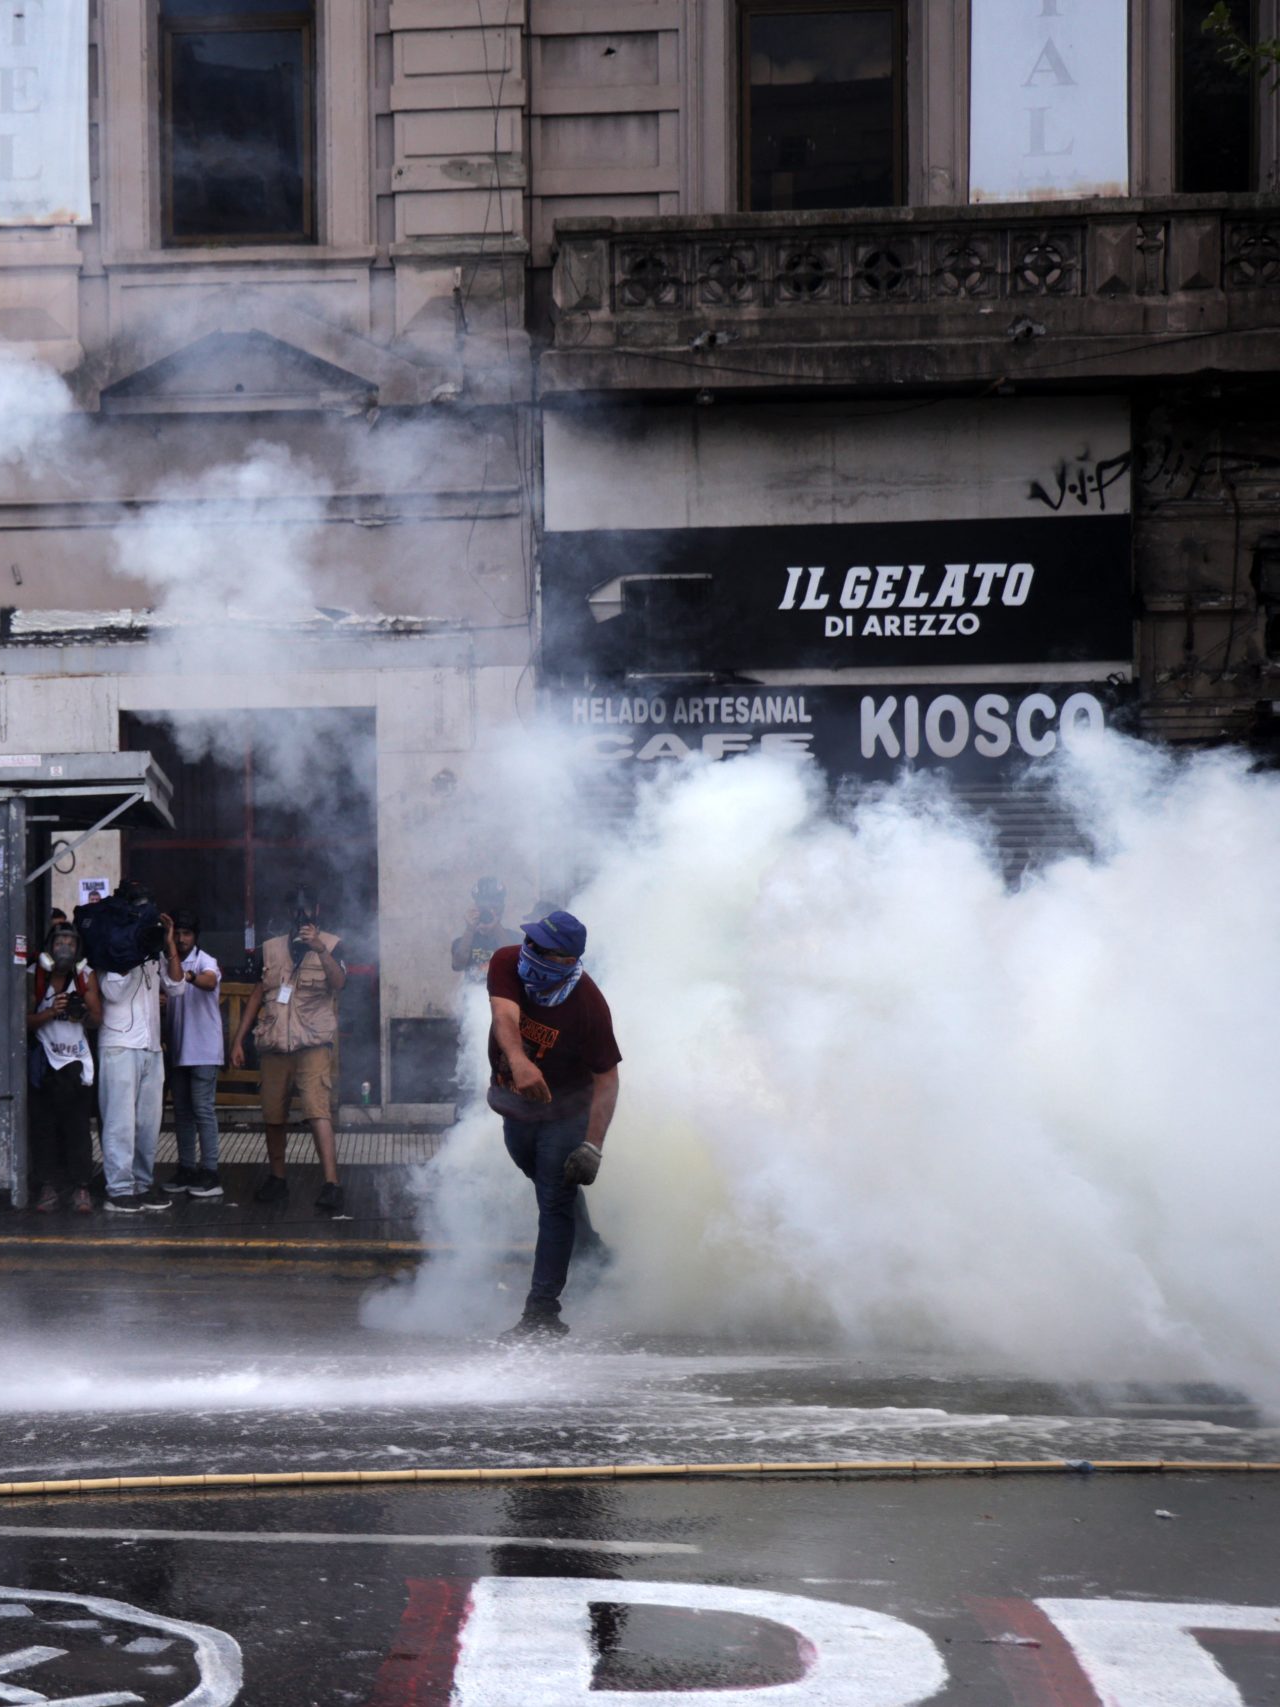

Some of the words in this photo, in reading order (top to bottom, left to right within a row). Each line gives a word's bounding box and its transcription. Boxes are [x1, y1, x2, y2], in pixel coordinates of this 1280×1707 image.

[778, 566, 830, 610] IL
[839, 563, 1035, 609] GELATO
[825, 615, 853, 637] DI
[862, 612, 980, 637] AREZZO
[572, 696, 666, 724] HELADO
[673, 695, 812, 724] ARTESANAL
[860, 692, 1105, 759] KIOSCO
